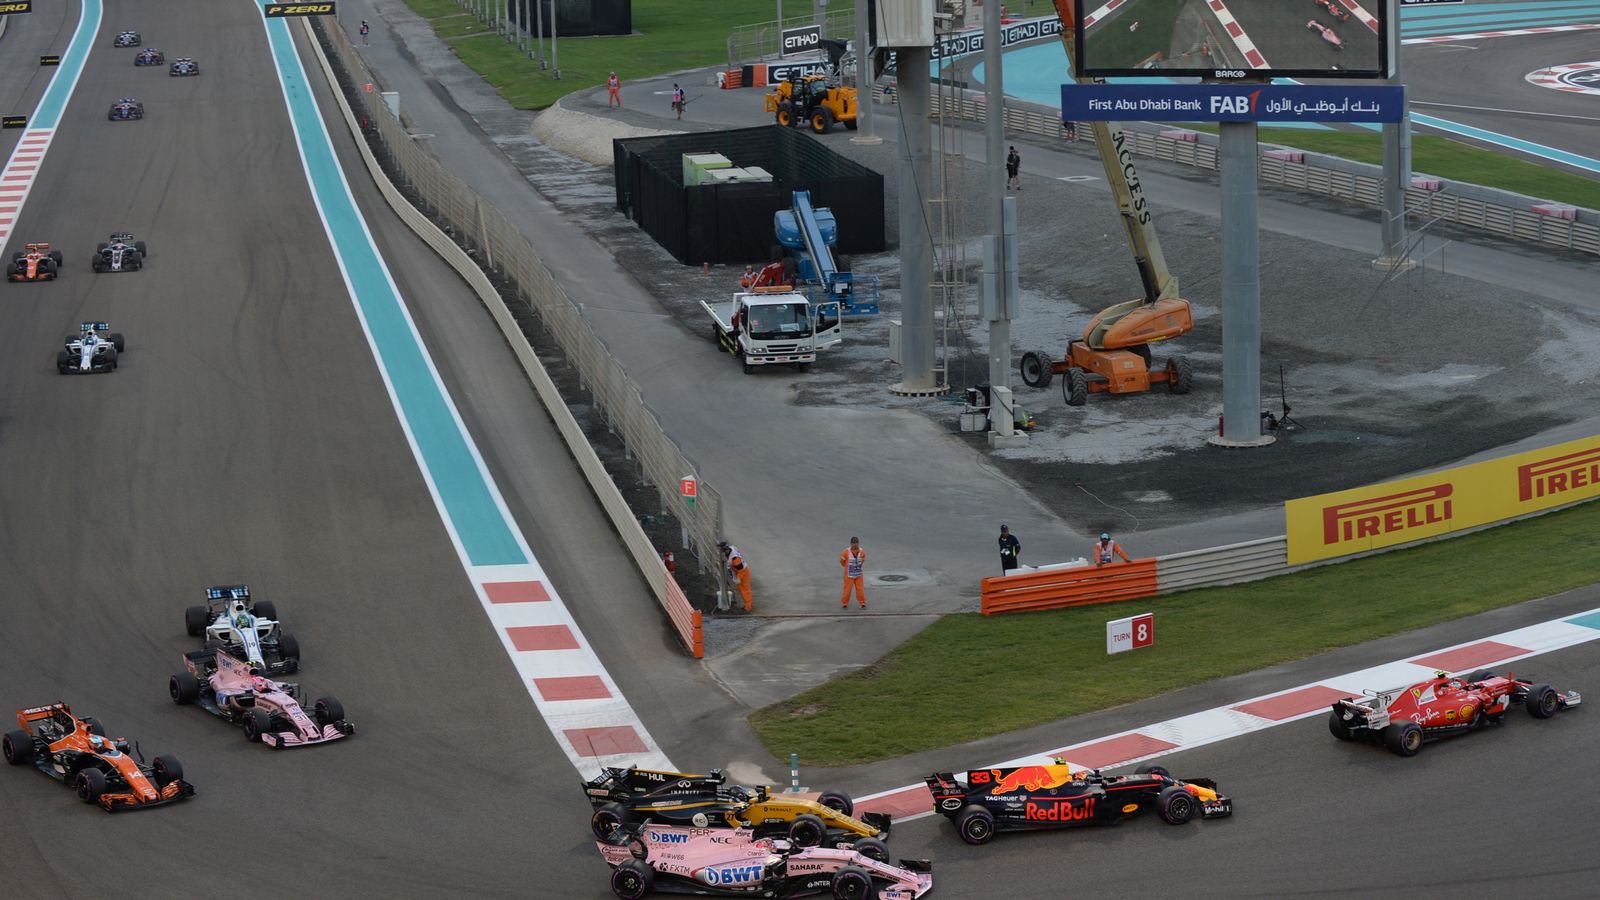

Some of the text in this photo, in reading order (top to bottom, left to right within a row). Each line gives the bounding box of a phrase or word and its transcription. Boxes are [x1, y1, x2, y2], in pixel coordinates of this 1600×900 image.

[269, 4, 332, 14] P ZERO
[1009, 25, 1037, 40] ETIHAD
[784, 33, 819, 48] ETIHAD
[1215, 70, 1246, 78] BARCO
[1088, 99, 1202, 110] First Abu Dhabi Bank
[1210, 95, 1249, 114] FAB
[1112, 131, 1151, 225] ACCESS
[684, 481, 693, 494] F
[1323, 482, 1453, 545] PIRELLI
[1113, 623, 1148, 643] TURN 8
[1410, 707, 1440, 725] Ray-Ban
[127, 771, 143, 779] 14
[648, 773, 666, 782] HUL
[970, 771, 990, 784] 33
[1026, 797, 1096, 821] Red Bull
[726, 813, 735, 821] 27
[661, 833, 688, 844] BWT
[690, 828, 710, 836] PER
[710, 837, 732, 845] NEC
[669, 864, 691, 874] FXTM
[721, 865, 762, 885] BWT
